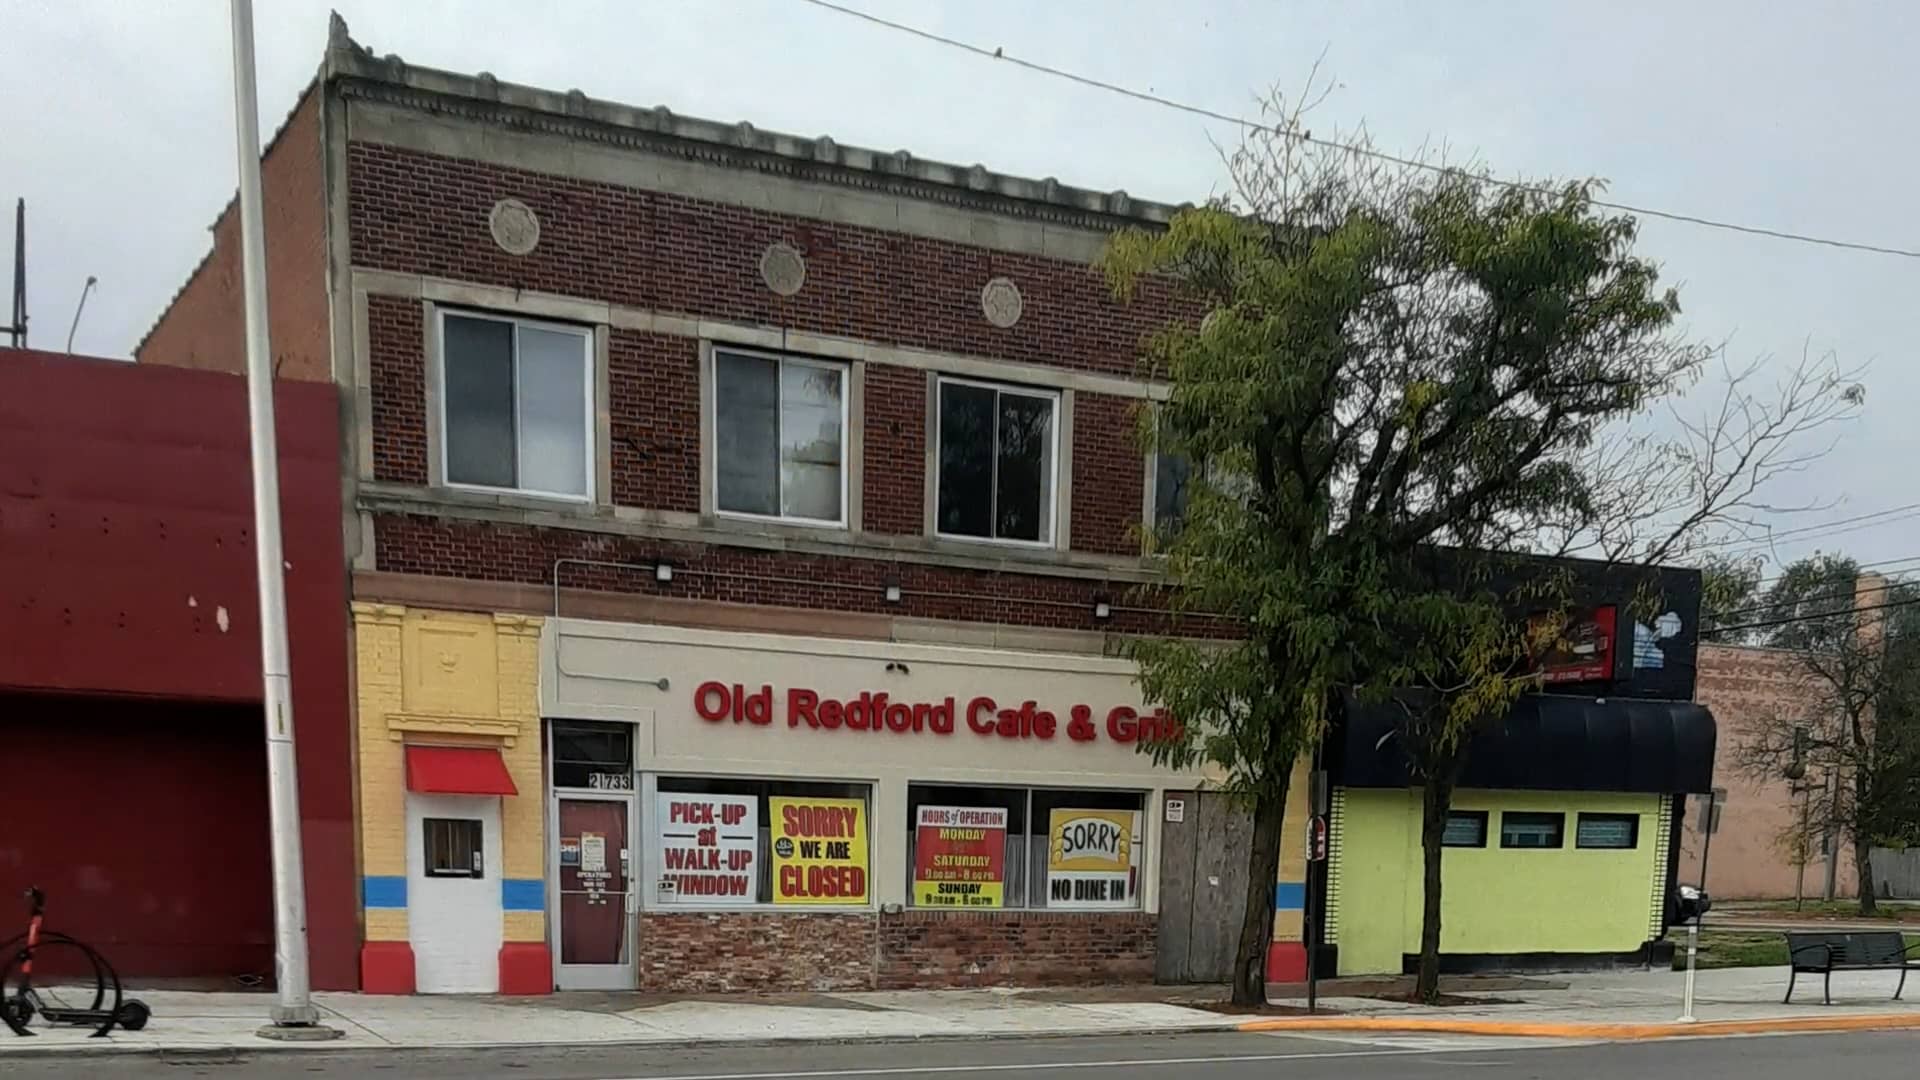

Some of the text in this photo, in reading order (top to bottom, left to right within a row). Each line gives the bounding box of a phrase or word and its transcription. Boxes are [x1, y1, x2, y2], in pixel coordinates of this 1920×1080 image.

[694, 681, 773, 725] Old
[787, 689, 955, 735] Redford
[966, 697, 1057, 739] Cafe
[1066, 704, 1097, 741] &
[589, 774, 631, 790] 21733
[670, 802, 747, 825] PICK-UP
[782, 804, 858, 838] SORRY
[922, 809, 950, 824] HOURS
[960, 811, 1004, 825] OPERATION
[698, 825, 717, 847] at
[940, 828, 986, 840] MONDAY
[1062, 822, 1120, 853] SORRY
[664, 848, 753, 871] WALK-UP
[800, 840, 822, 859] WE
[826, 841, 851, 860] ARE
[934, 855, 991, 867] SATURDAY
[780, 865, 865, 898] CLOSED
[938, 883, 982, 895] SUNDAY
[1051, 879, 1125, 901] NO DINE IN
